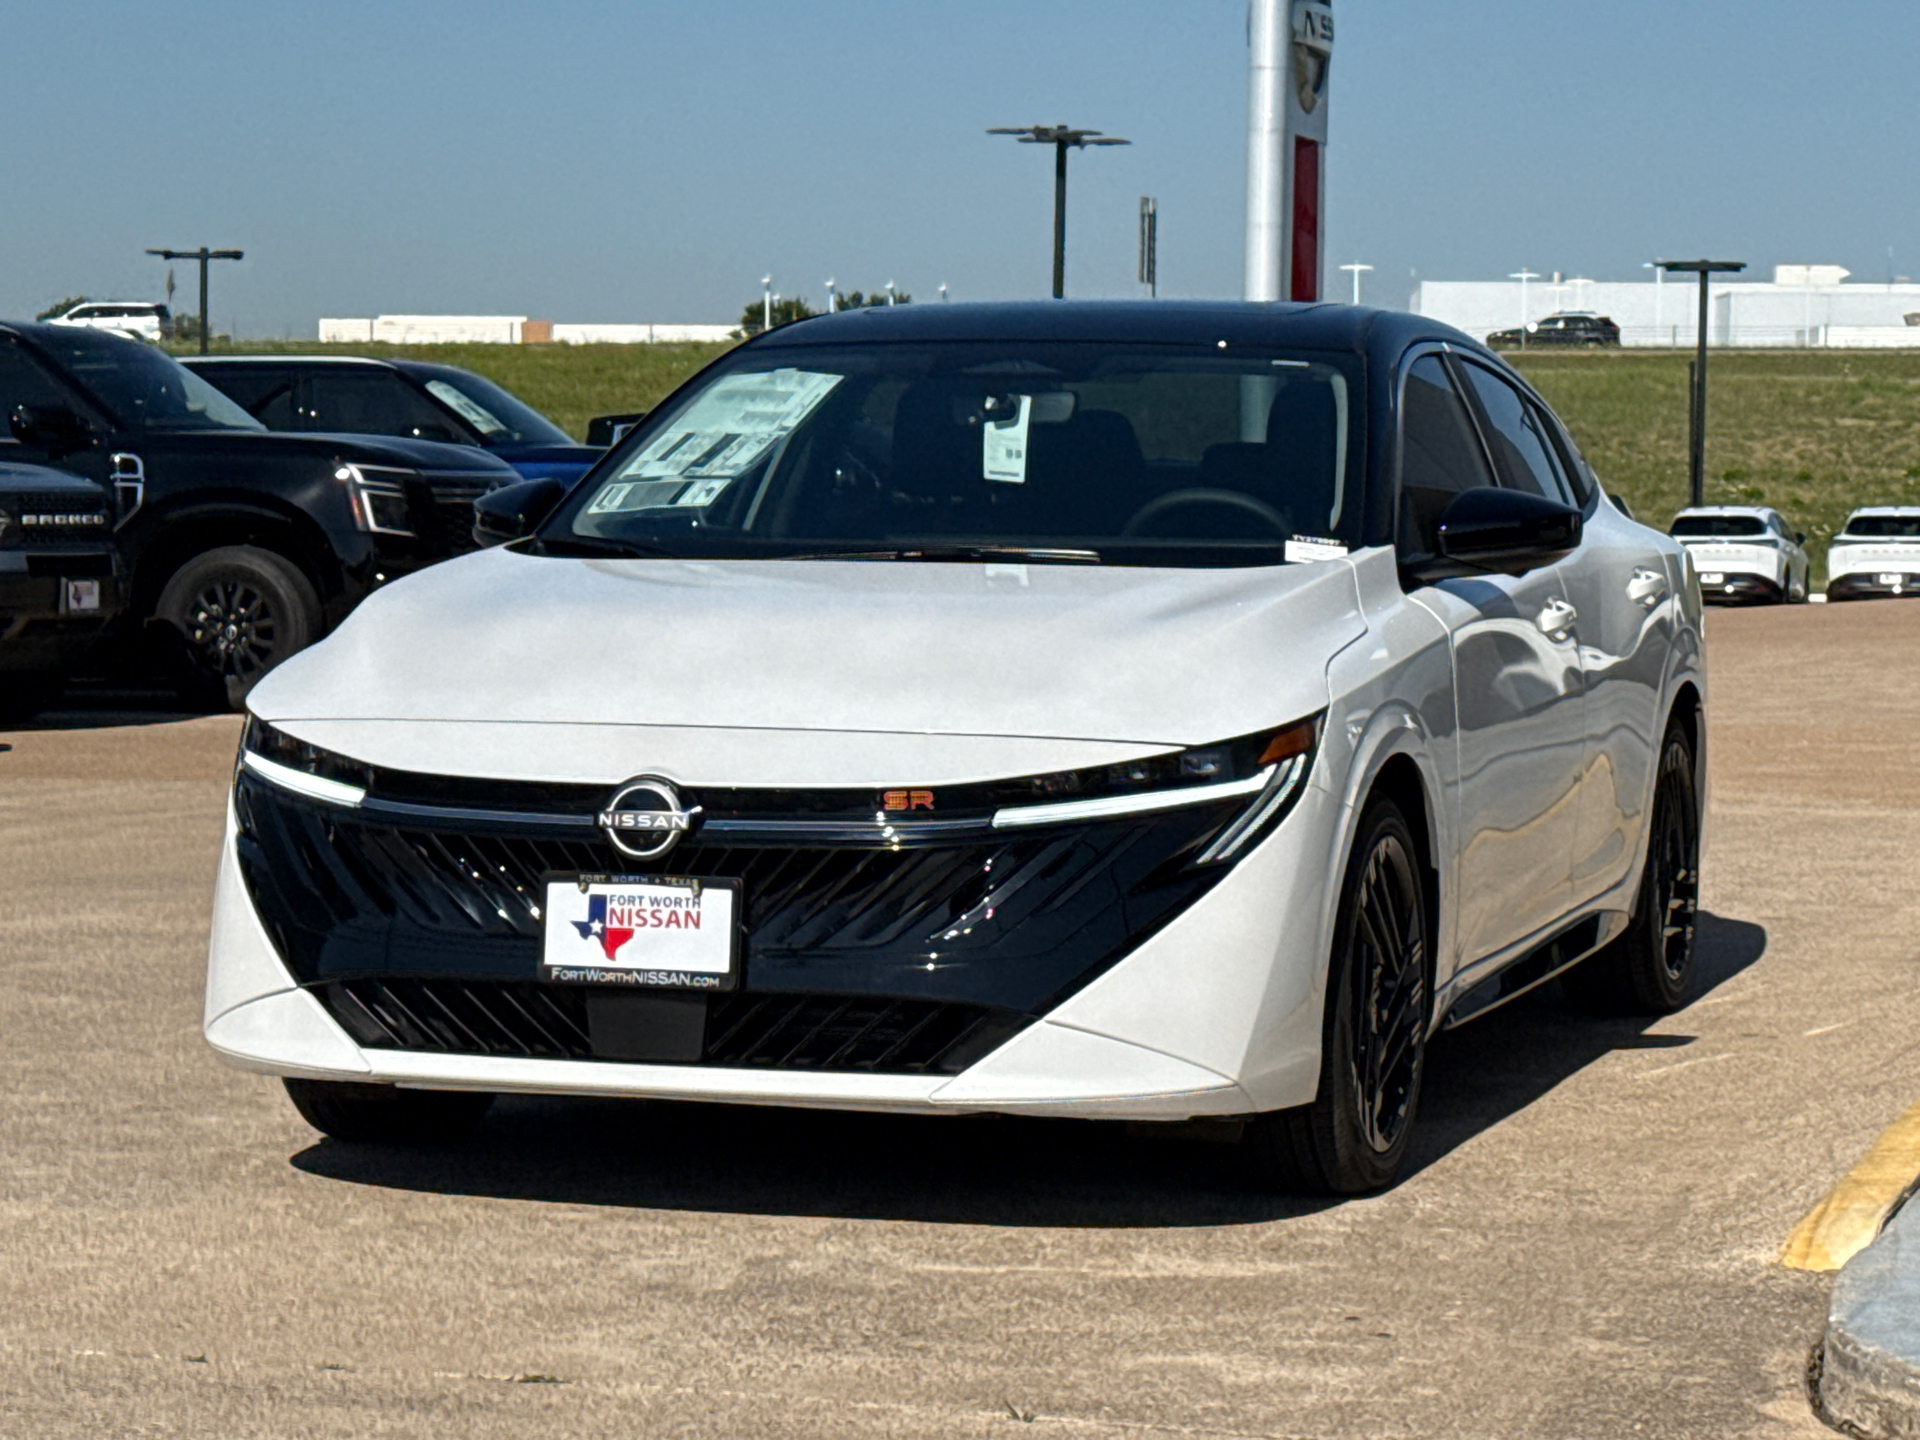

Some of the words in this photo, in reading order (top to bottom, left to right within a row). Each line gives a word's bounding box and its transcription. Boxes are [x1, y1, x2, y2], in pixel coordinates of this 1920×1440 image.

[22, 514, 105, 526] BRONCO
[883, 791, 935, 810] SR
[599, 813, 688, 830] NISSAN
[579, 874, 607, 882] FORT
[611, 874, 648, 884] WORTH
[664, 876, 700, 887] TEXAS
[609, 894, 645, 907] FORT
[649, 895, 701, 909] WORTH
[609, 907, 701, 930] NISSAN
